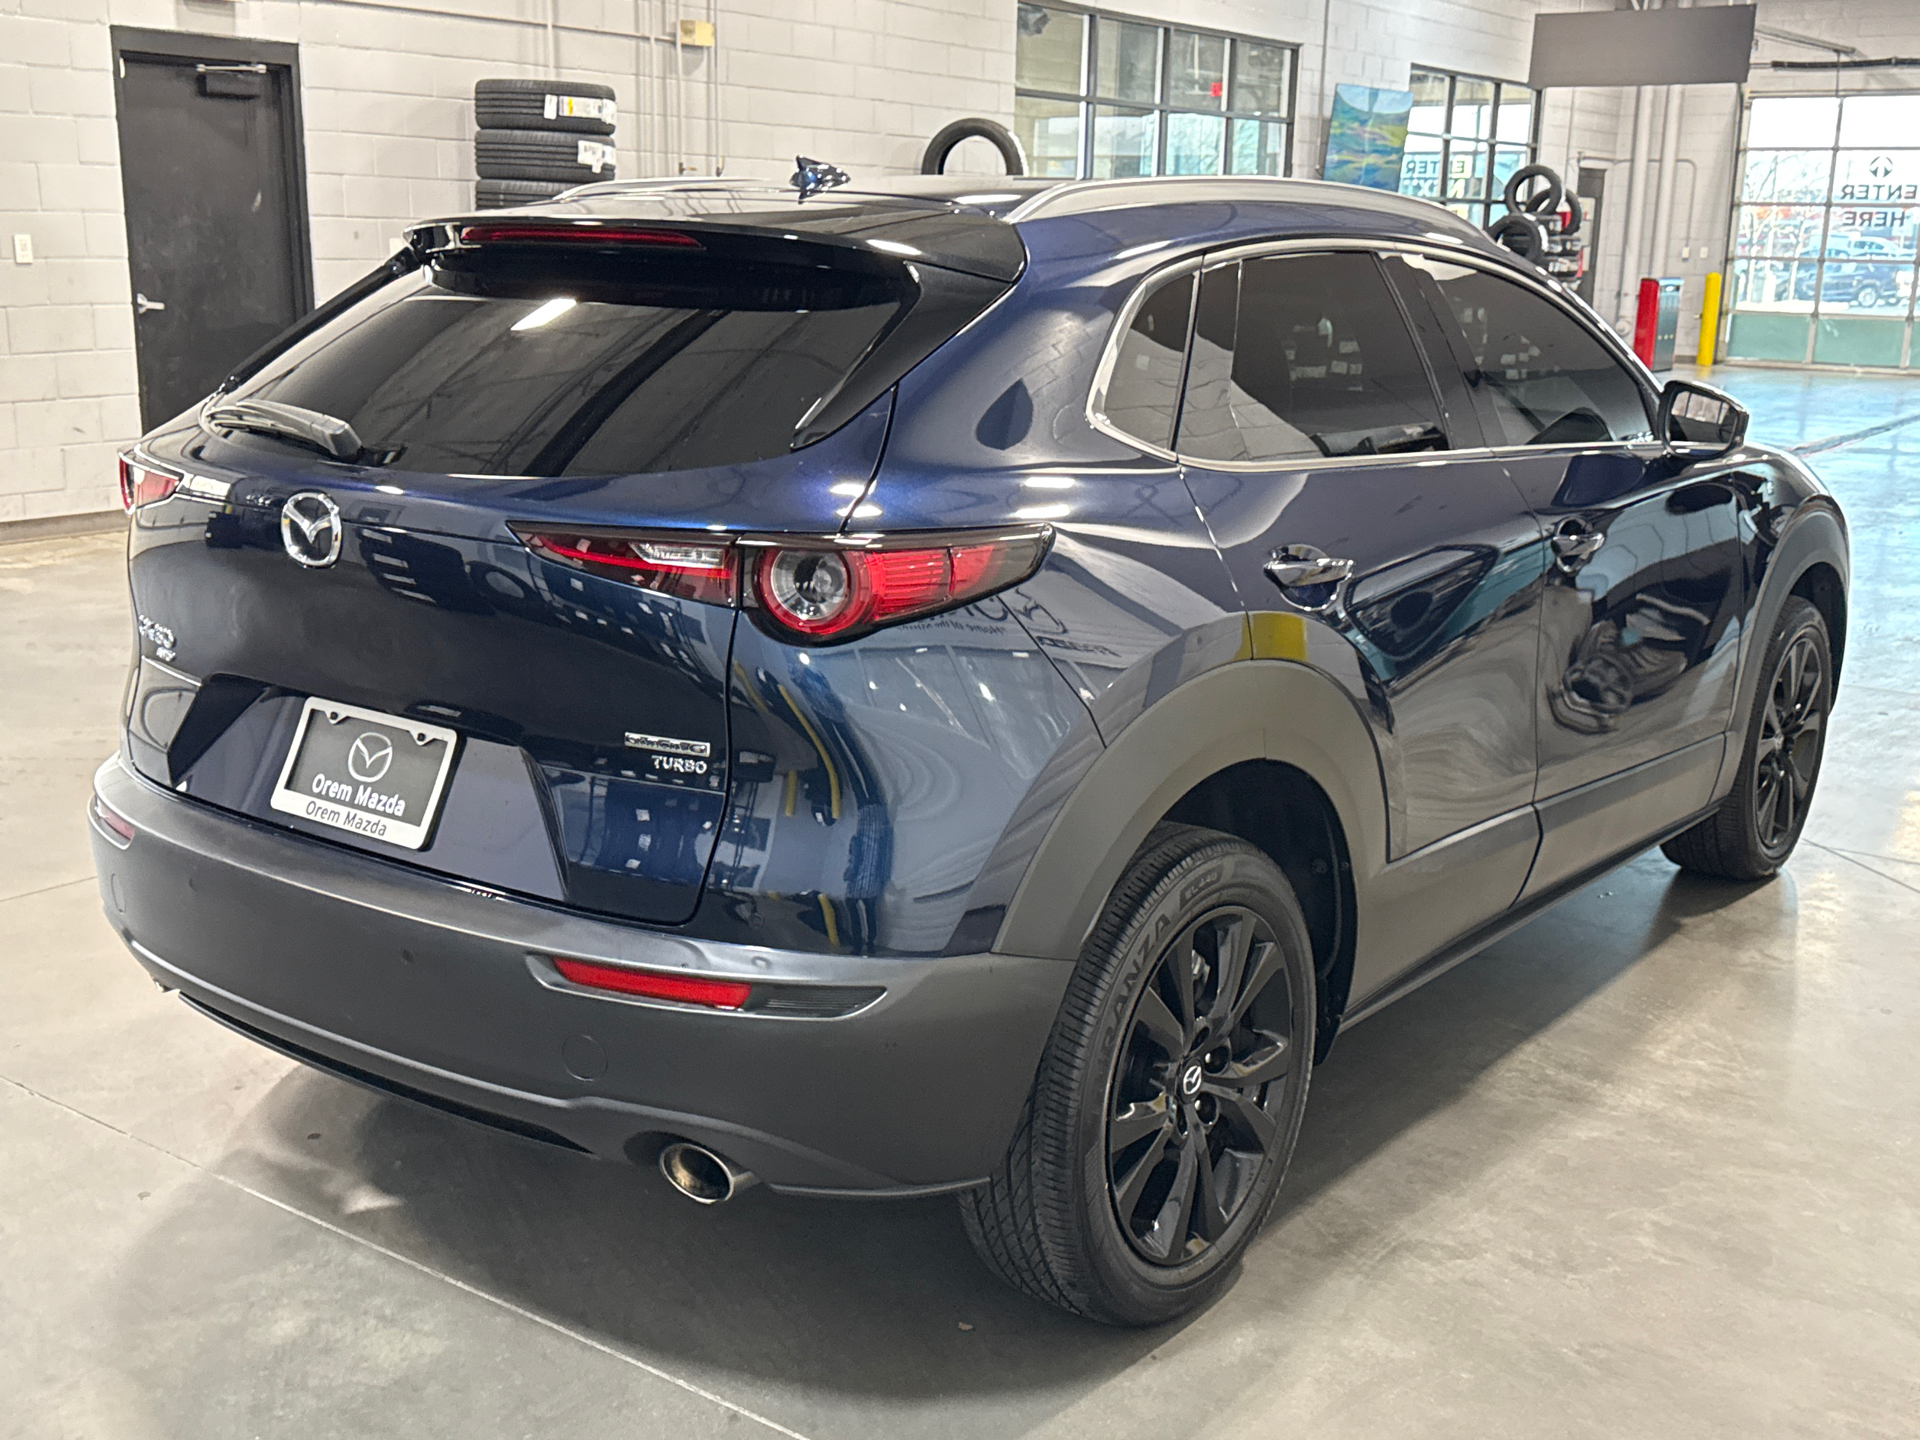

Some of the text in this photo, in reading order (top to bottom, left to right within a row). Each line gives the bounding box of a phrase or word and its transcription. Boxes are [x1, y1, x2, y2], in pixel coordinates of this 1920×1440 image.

[651, 754, 708, 774] TURBO
[312, 773, 406, 817] Orem Mazda
[305, 800, 388, 837] Orem Mazda
